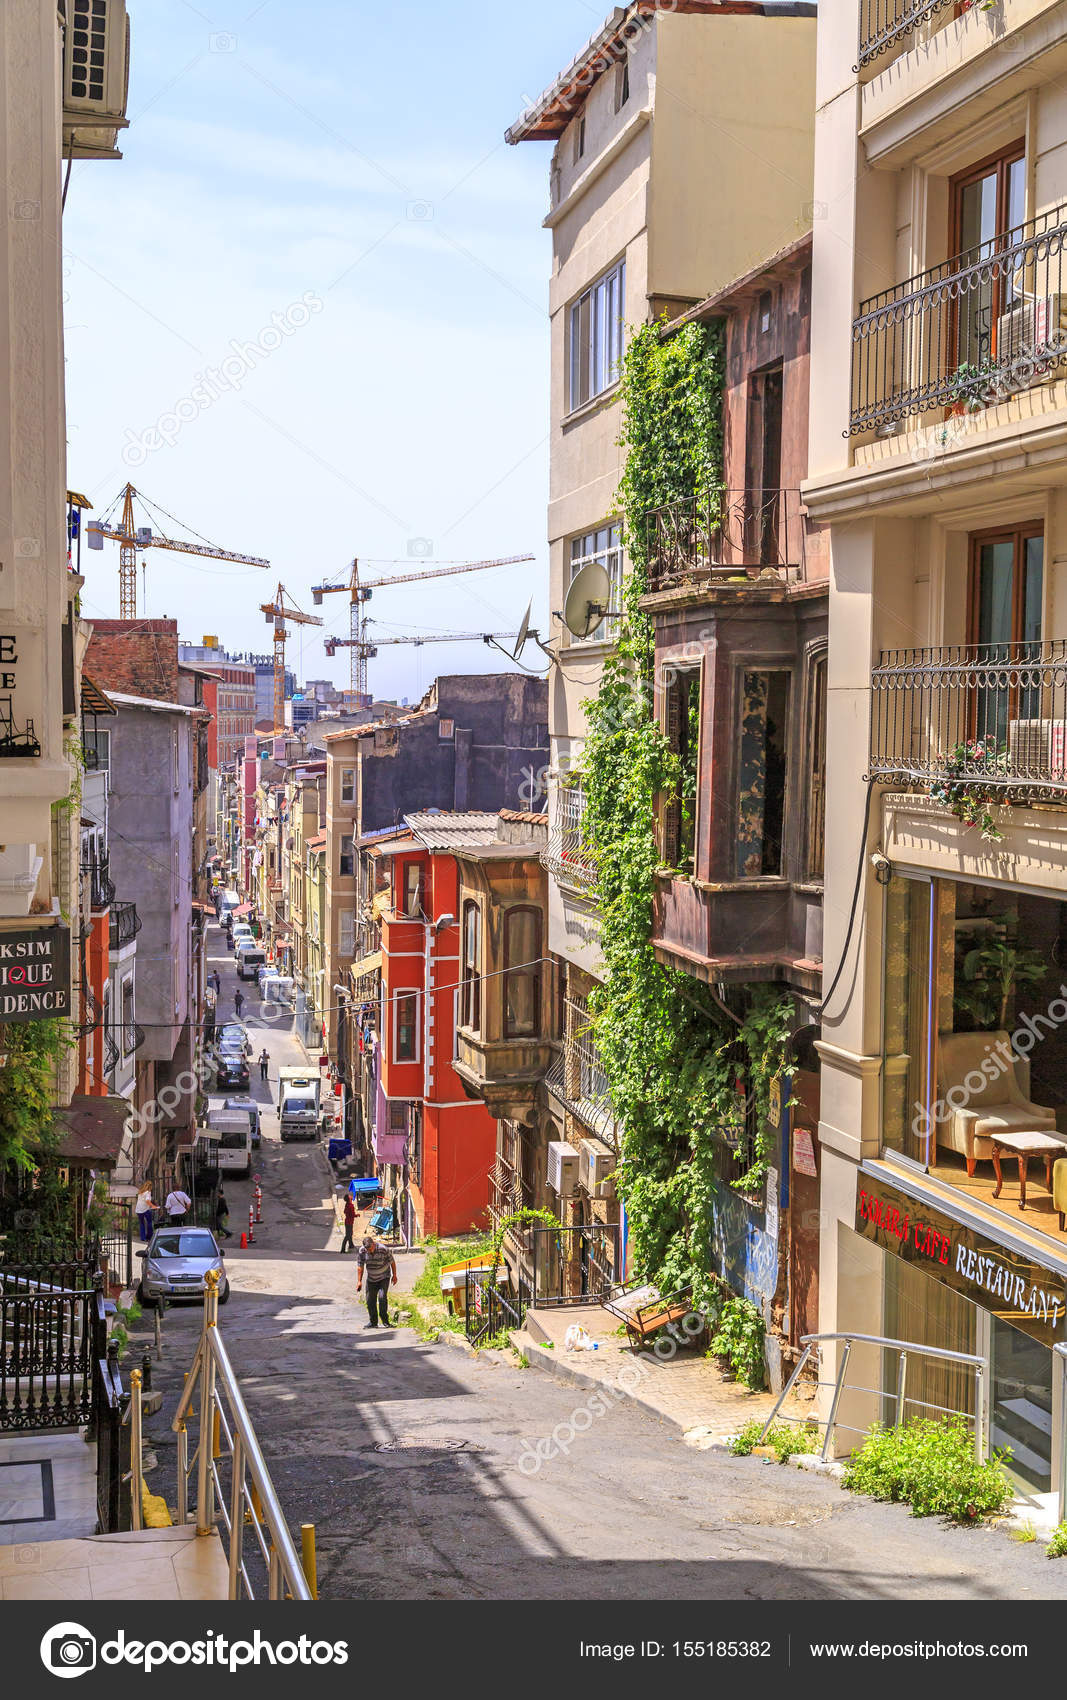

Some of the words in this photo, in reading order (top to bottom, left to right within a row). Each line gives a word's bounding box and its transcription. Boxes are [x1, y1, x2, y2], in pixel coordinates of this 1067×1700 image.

[0, 941, 52, 958] KSIM
[1, 963, 53, 987] IQUE
[914, 1223, 951, 1265] CAFE
[955, 1244, 1062, 1328] RESTAURANT
